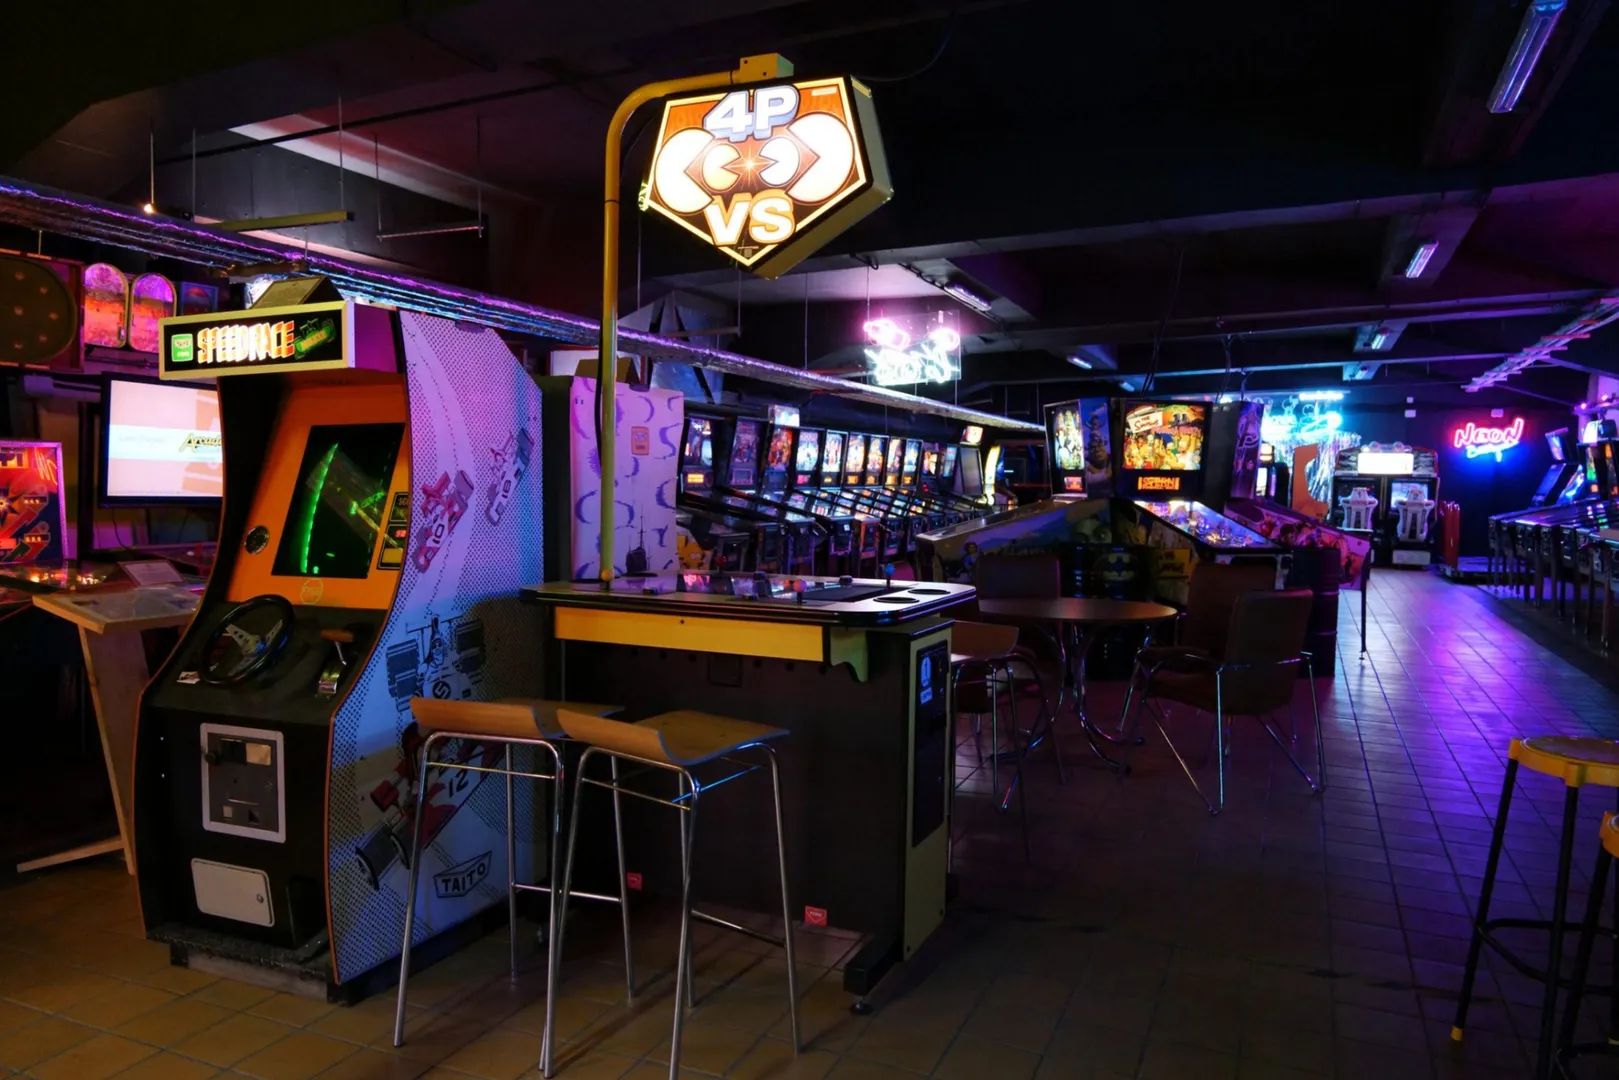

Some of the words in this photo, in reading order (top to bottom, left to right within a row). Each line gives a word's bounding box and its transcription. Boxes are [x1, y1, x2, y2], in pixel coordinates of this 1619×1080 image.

[704, 85, 800, 142] 4P
[704, 189, 796, 246] VS
[441, 862, 486, 893] TAITO
